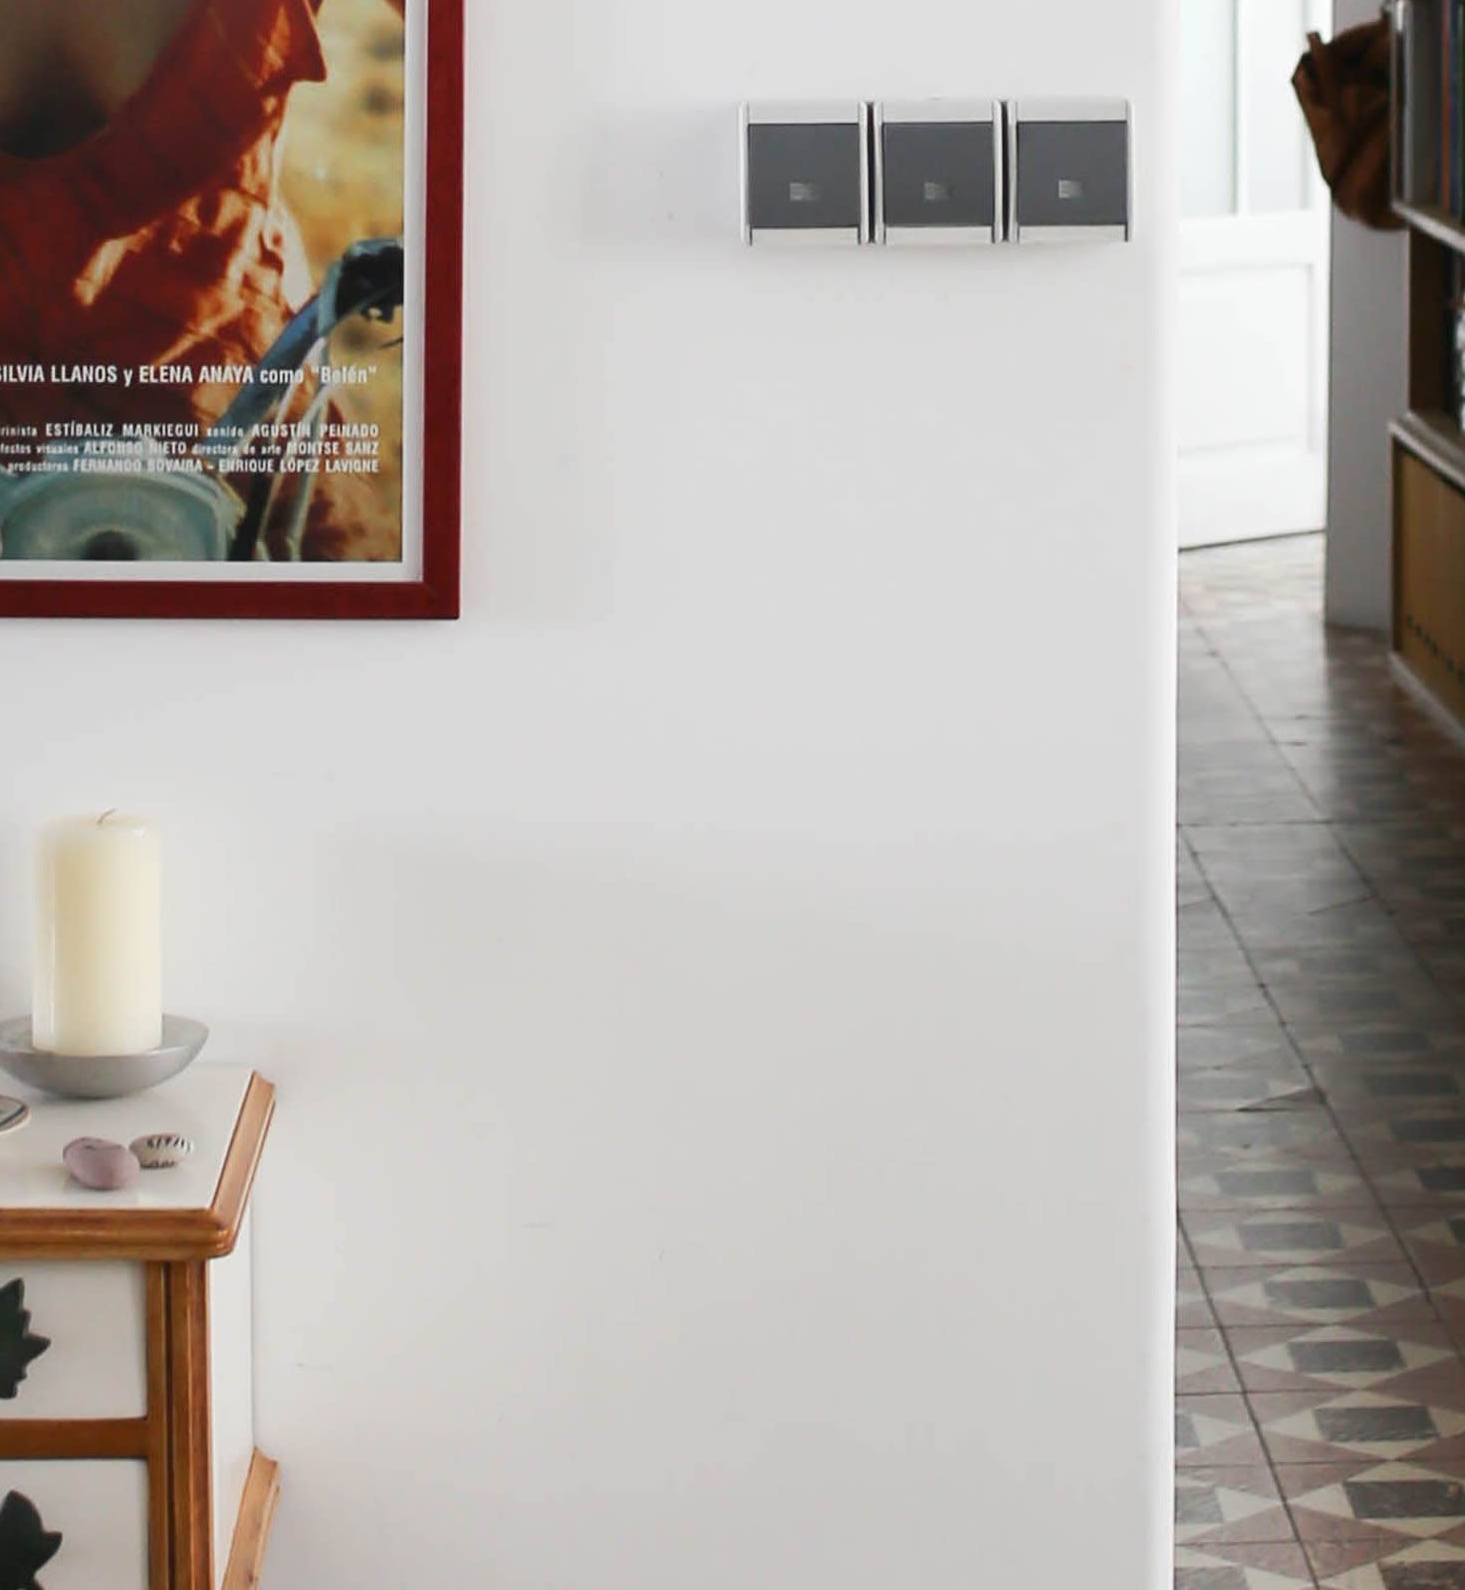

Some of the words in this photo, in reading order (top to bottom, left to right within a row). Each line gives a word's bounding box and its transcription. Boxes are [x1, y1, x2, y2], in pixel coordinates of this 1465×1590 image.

[51, 364, 118, 383] LLANOS
[123, 369, 133, 387] y
[139, 365, 193, 384] ELENA
[199, 365, 254, 384] ANAYA
[260, 368, 304, 384] como
[45, 420, 114, 437] ESTÍBALIZ
[122, 423, 199, 438] MARKIEGUI
[320, 423, 379, 438] PEINADO
[286, 441, 340, 455] MONTSE
[218, 459, 274, 472] ENRIQUE
[279, 455, 320, 472] LÓPEZ
[325, 459, 379, 473] LAVIGNE
